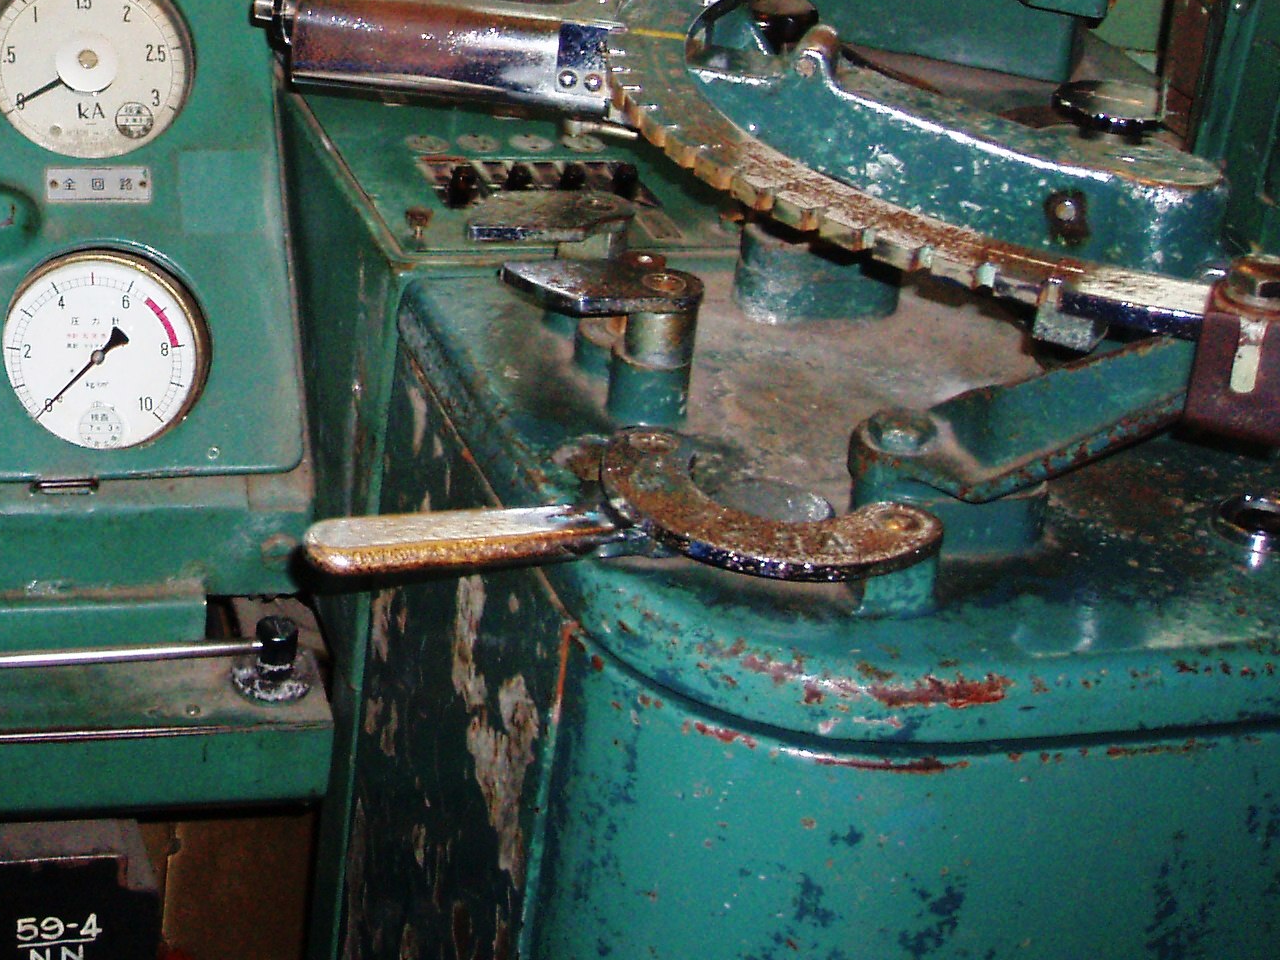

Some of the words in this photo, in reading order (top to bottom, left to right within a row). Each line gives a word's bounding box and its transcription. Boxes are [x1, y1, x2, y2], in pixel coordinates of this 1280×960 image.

[123, 6, 131, 22] 2
[146, 44, 166, 62] 2.5
[17, 93, 25, 110] 0
[151, 89, 160, 106] 3
[78, 103, 106, 120] kA
[58, 296, 65, 309] 4
[122, 295, 130, 309] 6
[24, 344, 31, 358] 2
[160, 342, 168, 356] 8
[45, 399, 52, 412] 0
[139, 397, 152, 411] 10
[16, 913, 103, 941] 59-4
